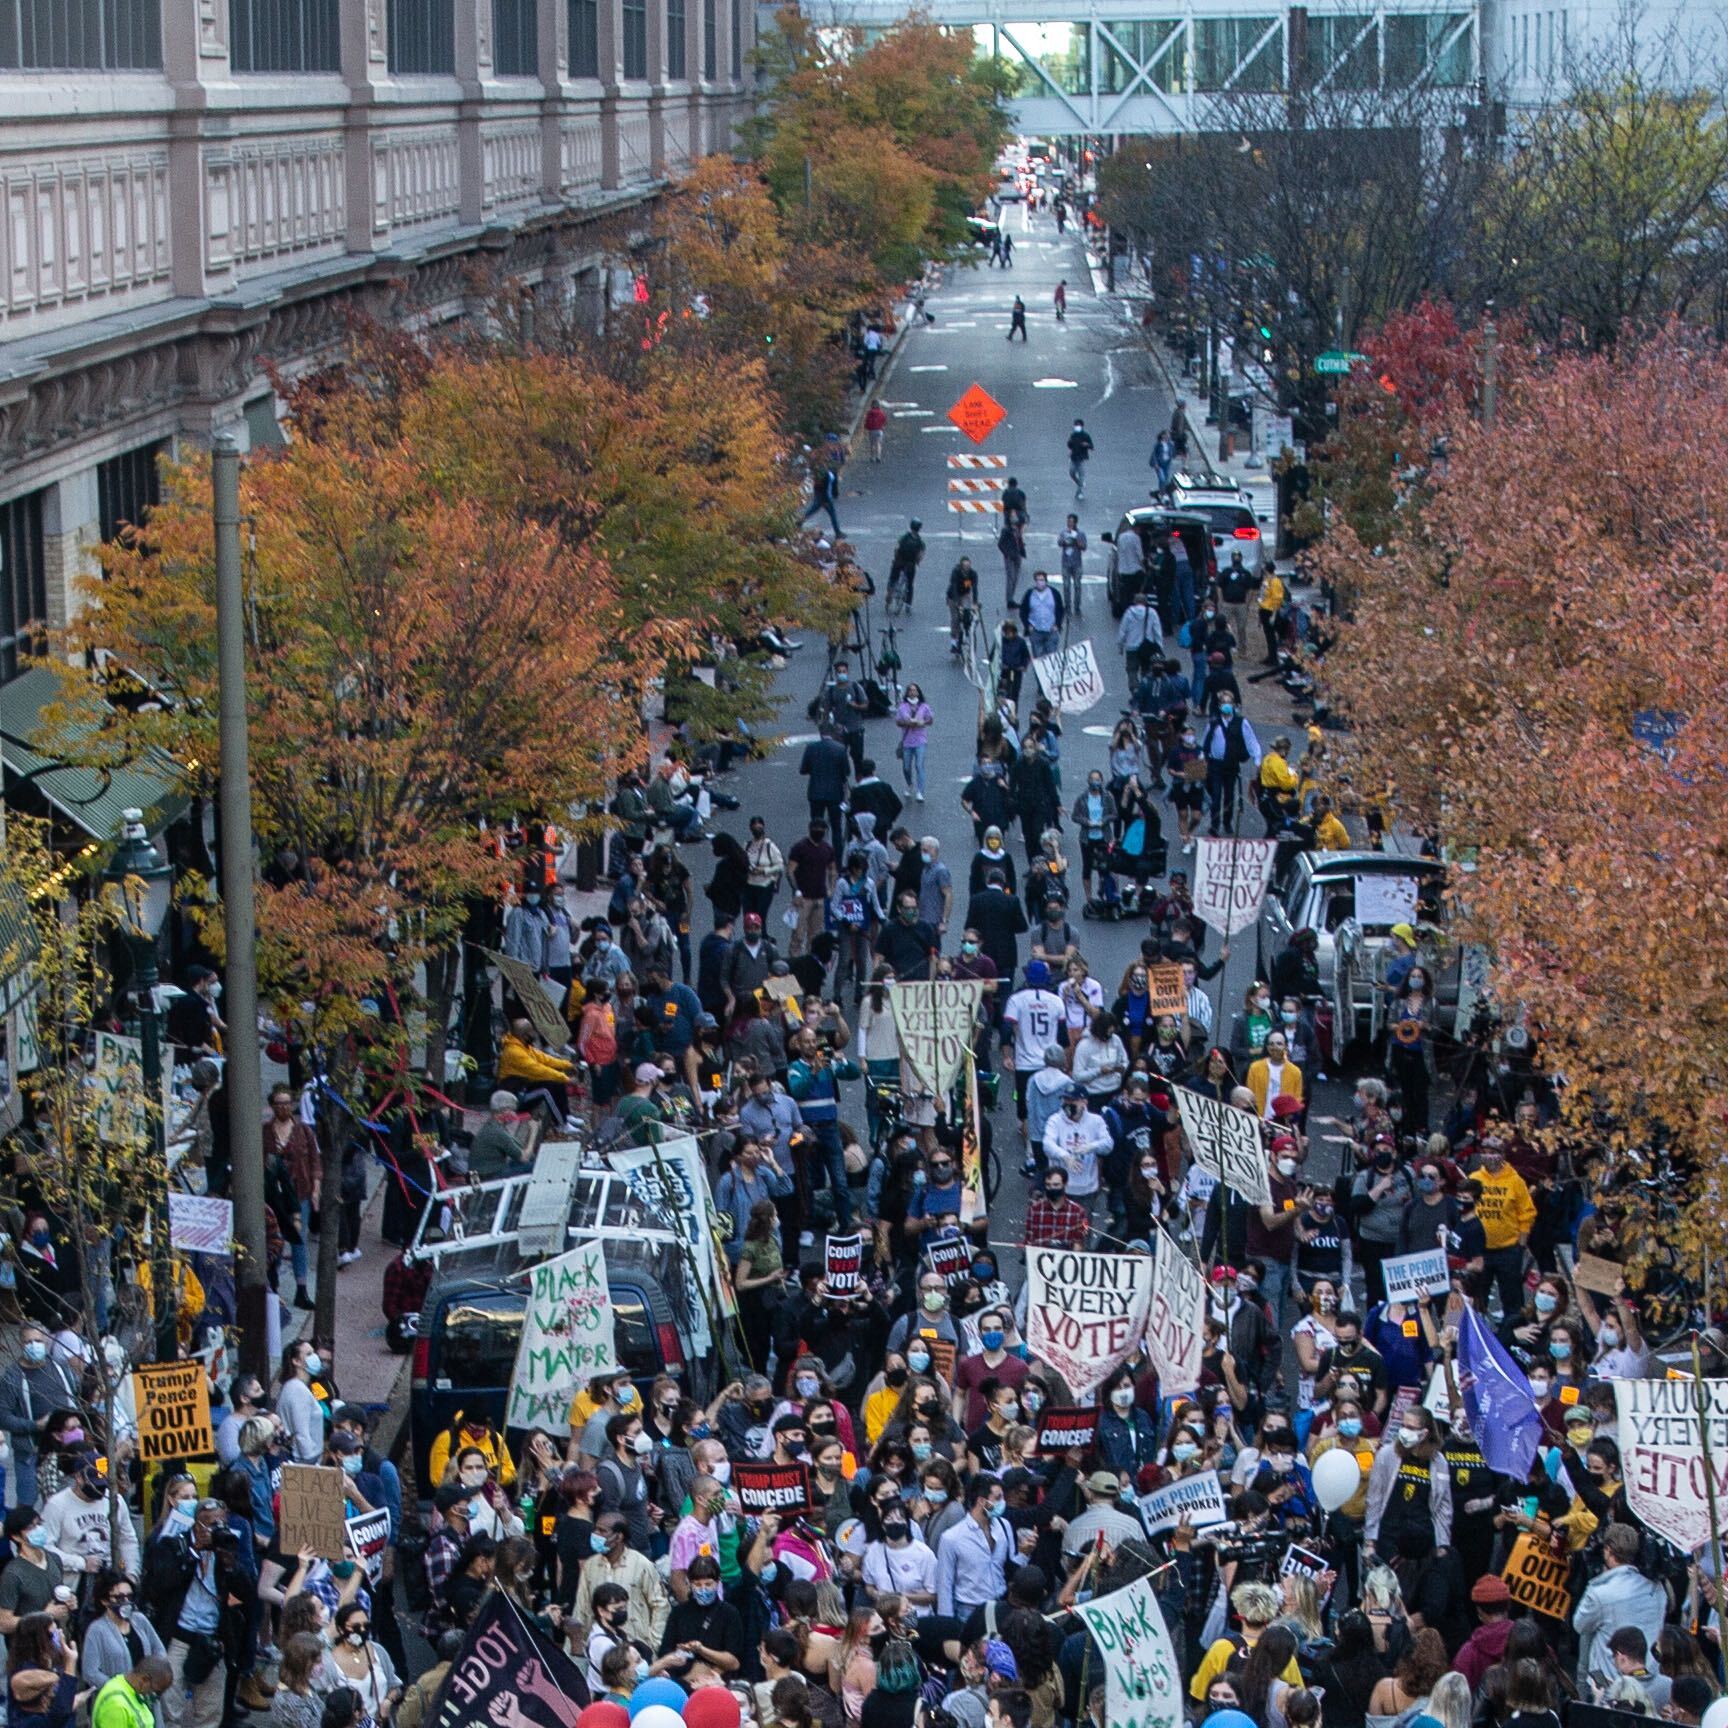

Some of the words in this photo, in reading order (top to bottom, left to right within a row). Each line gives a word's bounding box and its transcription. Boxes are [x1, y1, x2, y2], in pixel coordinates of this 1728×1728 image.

[1029, 1011, 1048, 1036] 15
[828, 1244, 862, 1258] COUNT
[932, 1244, 966, 1262] COUNT
[1037, 1253, 1143, 1290] COUNT
[1045, 1281, 1137, 1316] EVERY
[1034, 1303, 1131, 1358] VOTE
[139, 1368, 199, 1390] Trump/
[145, 1387, 198, 1405] Pence
[150, 1404, 197, 1431] OUT
[142, 1426, 210, 1458] NOW!
[1041, 1428, 1094, 1447] CONCEDE
[738, 1470, 771, 1489] TRUMP
[772, 1470, 801, 1488] MUST
[740, 1485, 805, 1507] CONCEDE
[1147, 1507, 1175, 1525] HAVE
[1177, 1499, 1221, 1514] SPOKEN
[1521, 1553, 1569, 1585] OUT
[1505, 1572, 1569, 1615] NOW!
